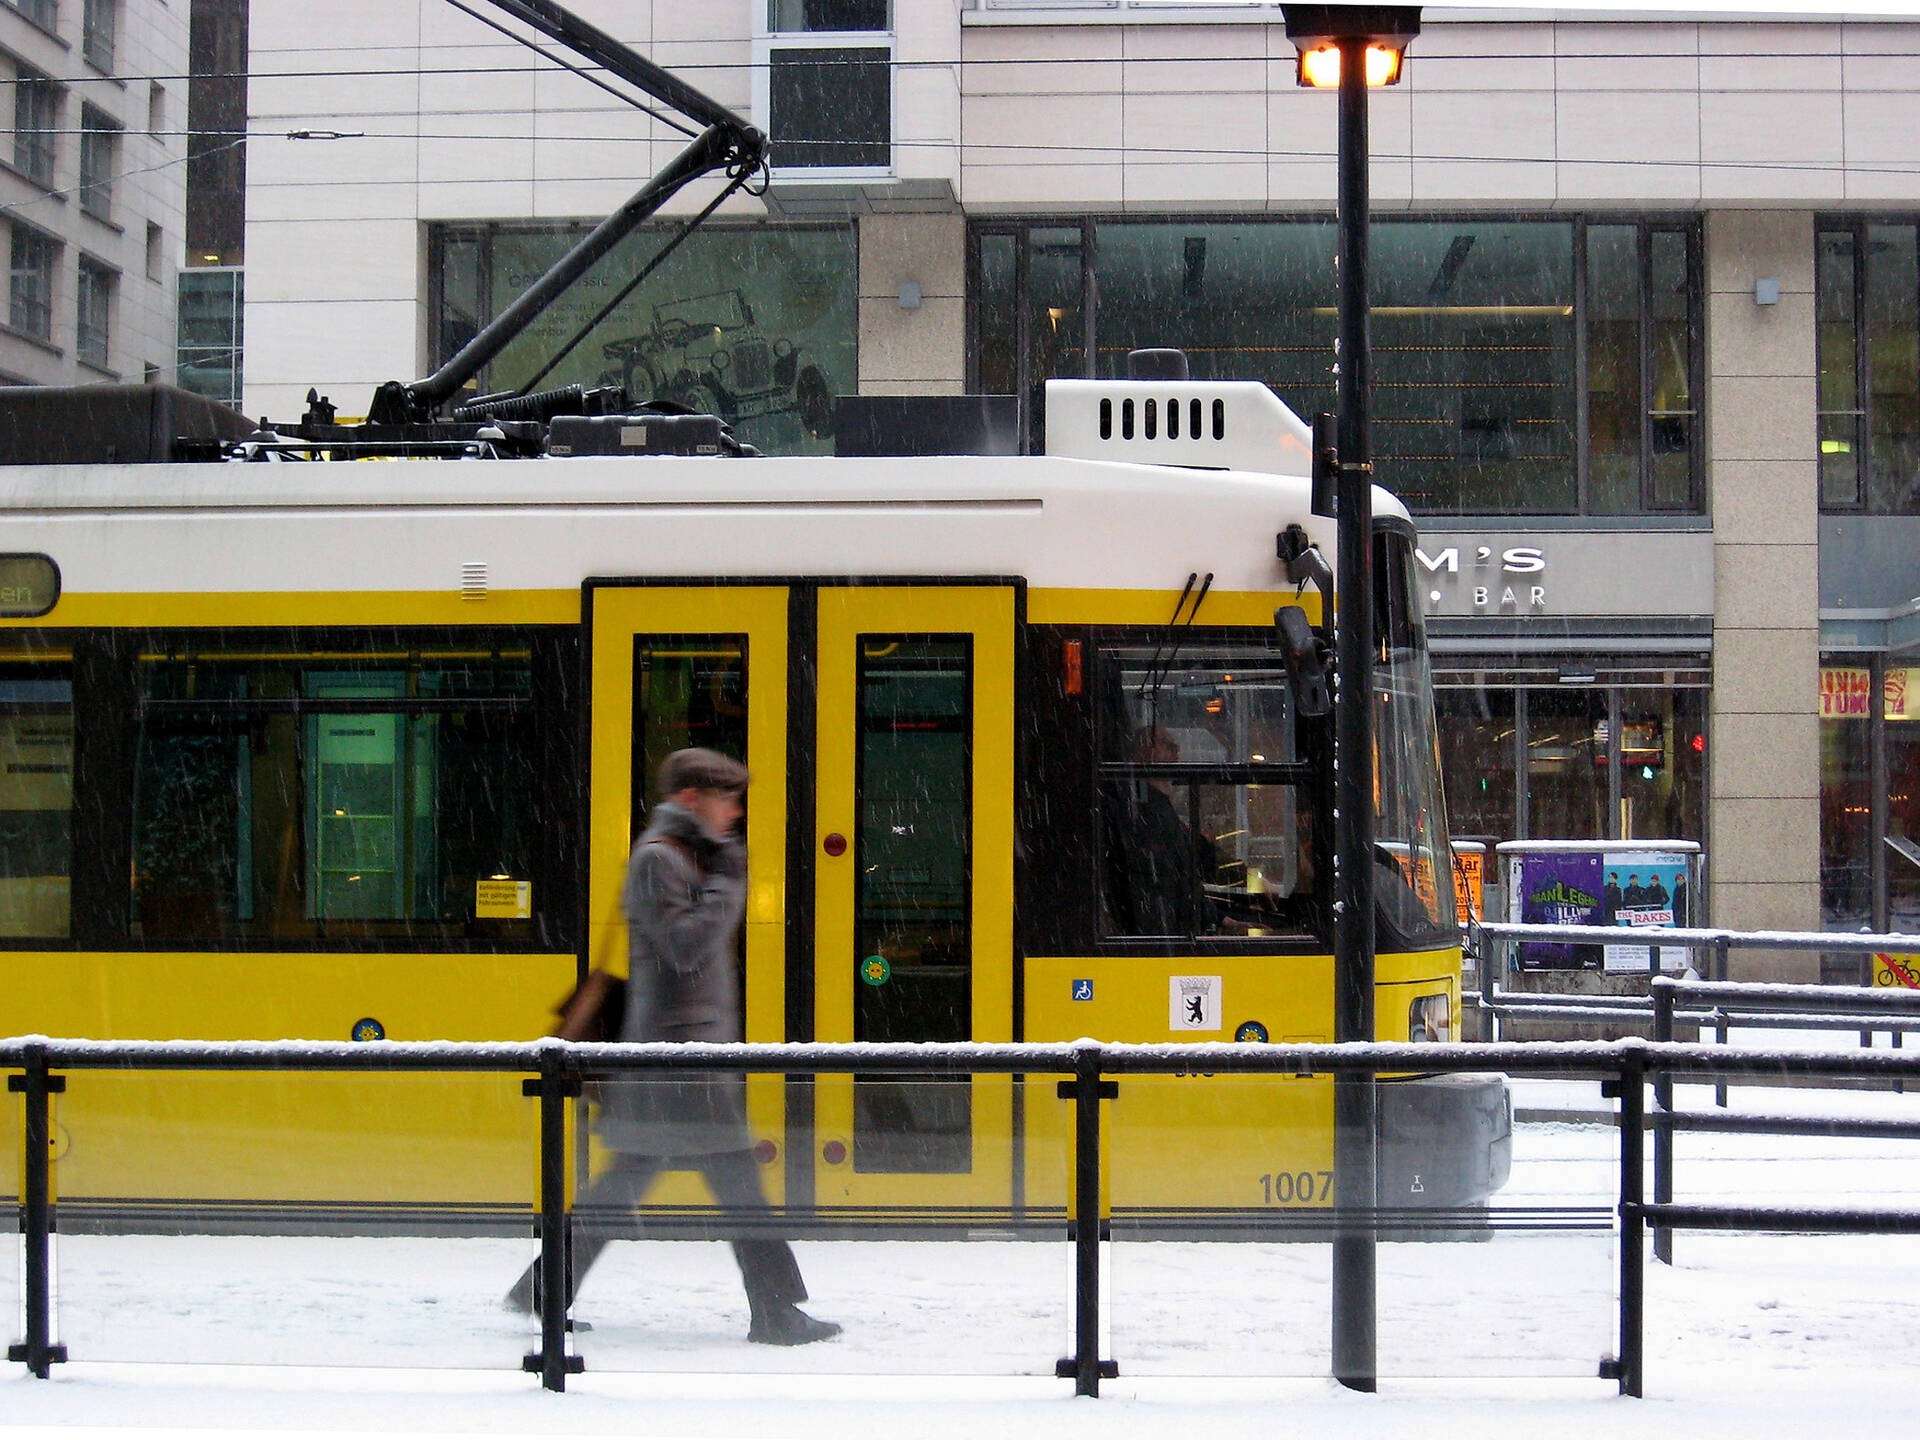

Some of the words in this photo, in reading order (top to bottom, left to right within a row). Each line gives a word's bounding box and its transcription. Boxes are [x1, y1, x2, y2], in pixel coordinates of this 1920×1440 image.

[1474, 586, 1546, 605] BAR
[1617, 911, 1633, 919] THE
[1634, 912, 1672, 923] RAKES
[1260, 1171, 1335, 1203] 1007
